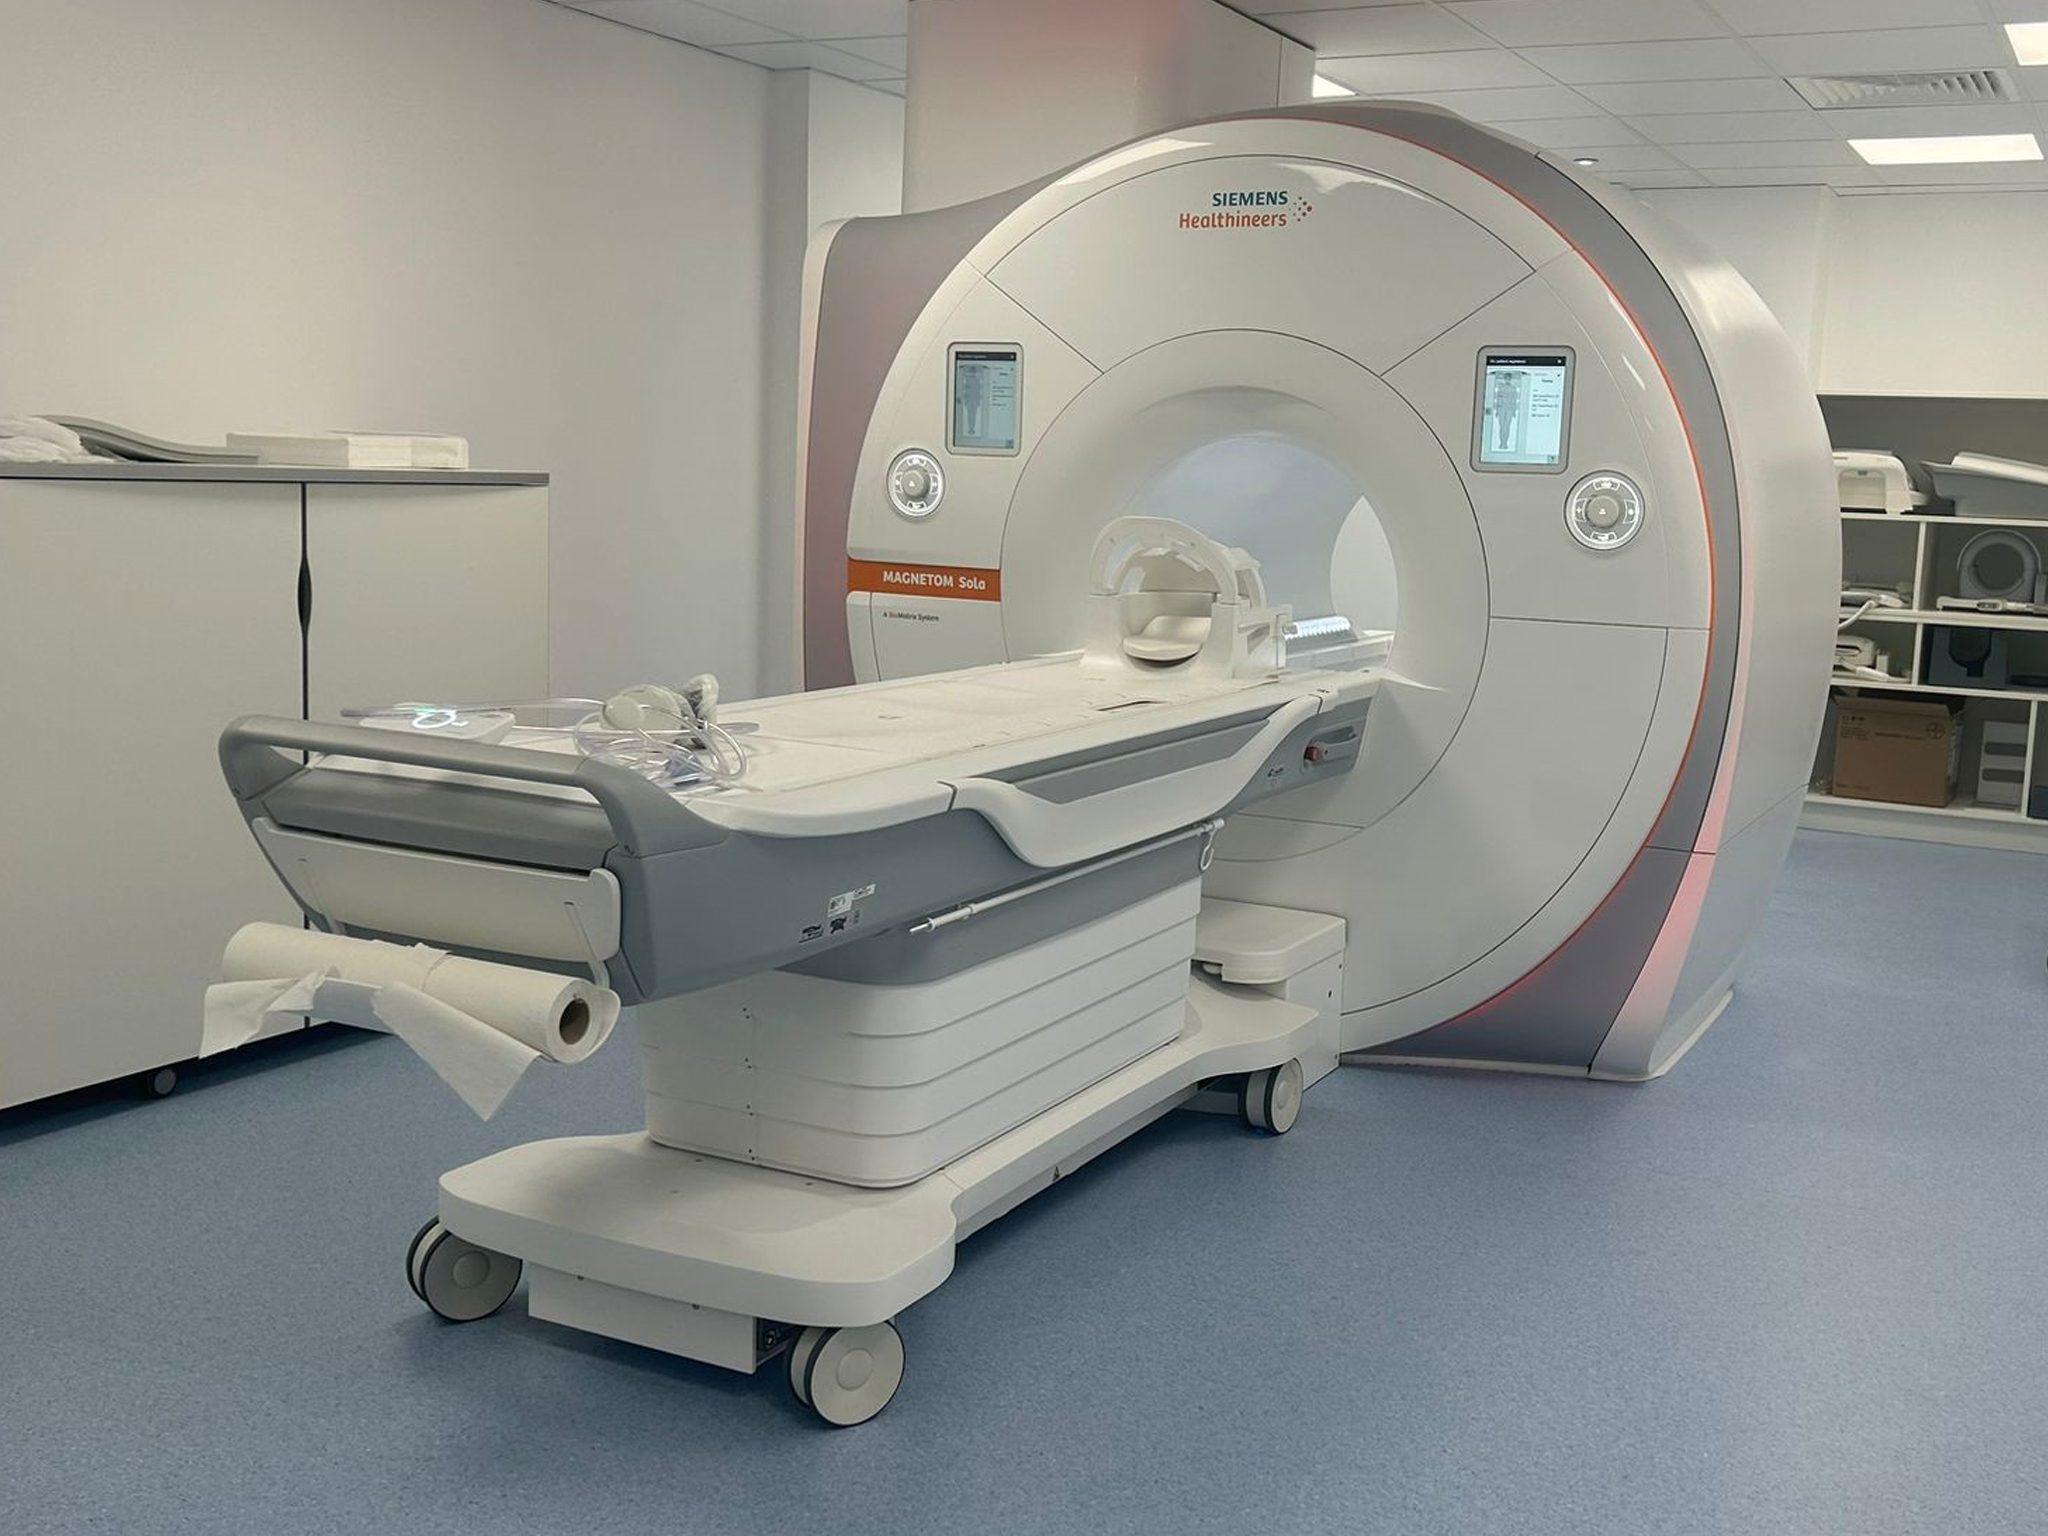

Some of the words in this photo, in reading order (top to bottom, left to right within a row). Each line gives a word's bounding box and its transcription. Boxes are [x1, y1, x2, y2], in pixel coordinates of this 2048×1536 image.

[1212, 191, 1288, 206] SIEMENS
[1179, 210, 1287, 228] Healthineers
[882, 570, 954, 587] MAGNETOM
[958, 576, 986, 590] Sola
